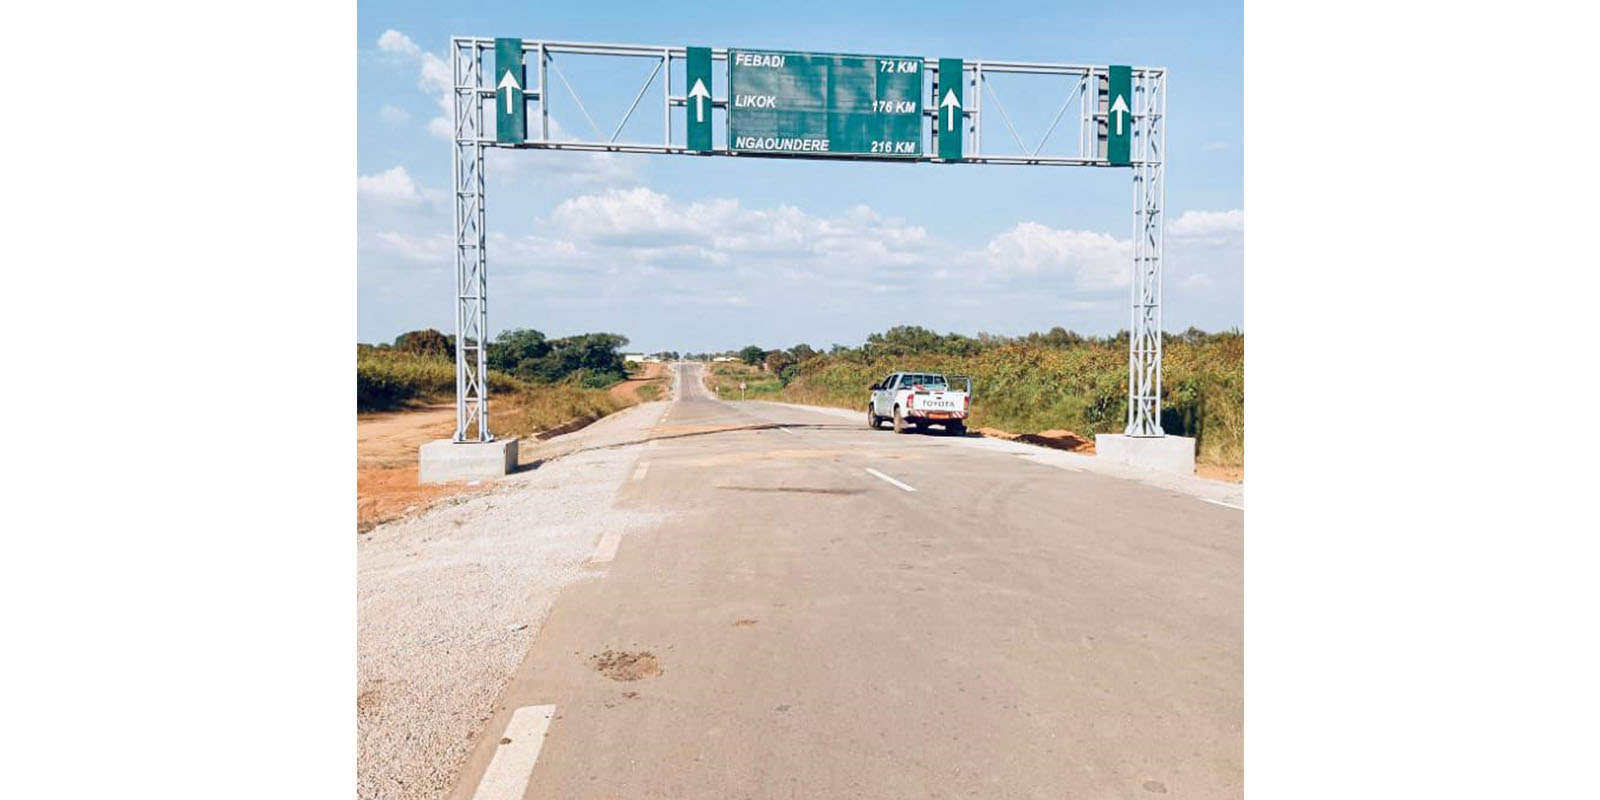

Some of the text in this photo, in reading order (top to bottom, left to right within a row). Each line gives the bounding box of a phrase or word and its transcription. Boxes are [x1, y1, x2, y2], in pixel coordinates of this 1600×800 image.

[735, 54, 785, 68] FEBADI
[880, 60, 917, 73] 72 KM
[735, 95, 776, 108] LIKOK
[872, 101, 916, 113] 176 KM
[735, 137, 830, 151] NGAOUNDERE
[871, 141, 915, 153] 216 KM
[922, 400, 955, 408] TOYOTA
